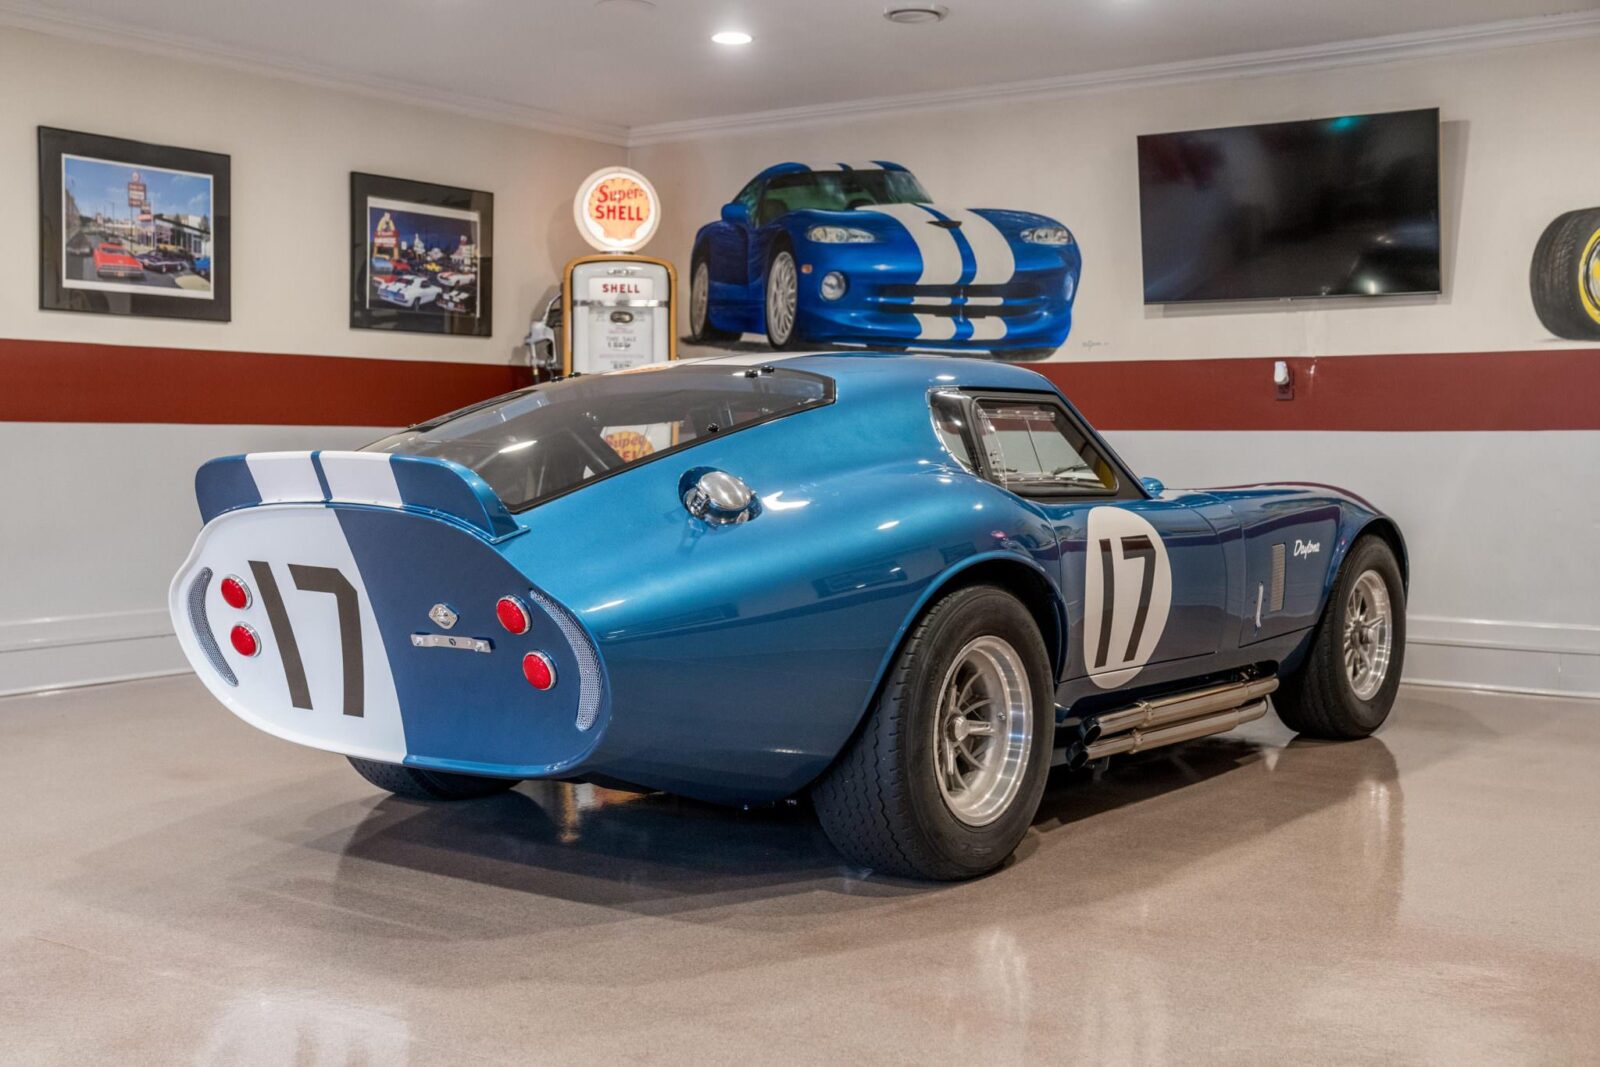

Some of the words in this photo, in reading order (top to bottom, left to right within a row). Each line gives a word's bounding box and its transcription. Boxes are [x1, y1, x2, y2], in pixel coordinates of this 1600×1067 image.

[595, 205, 643, 221] SHELL
[602, 283, 640, 294] SHELL
[1293, 539, 1320, 560] Daytona
[1094, 535, 1157, 669] 17
[248, 560, 365, 718] 17
